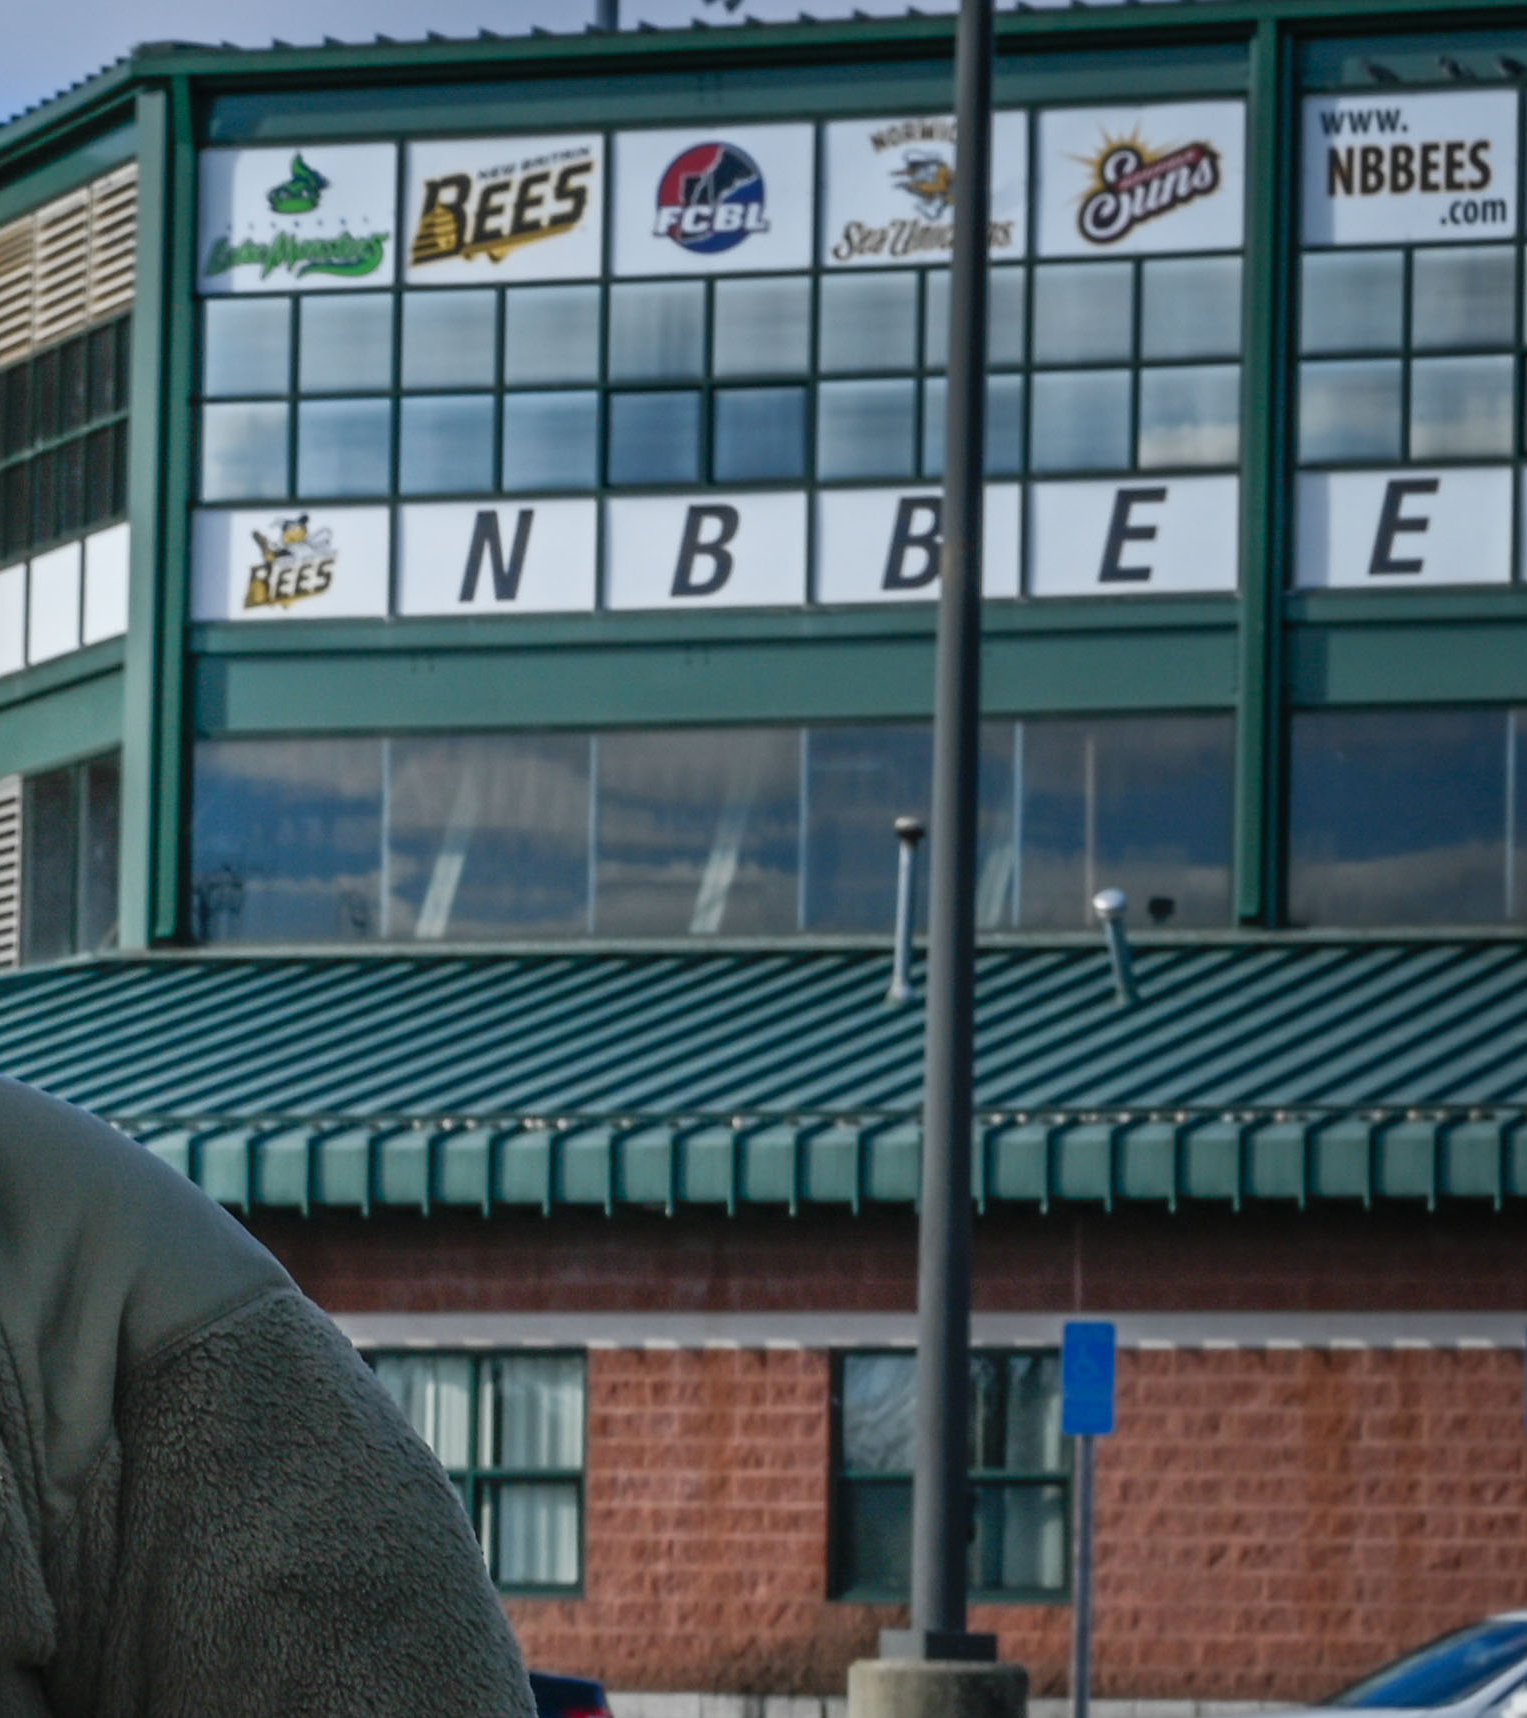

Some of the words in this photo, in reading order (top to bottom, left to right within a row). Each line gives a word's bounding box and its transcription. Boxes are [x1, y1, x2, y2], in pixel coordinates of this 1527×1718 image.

[1078, 143, 1220, 245] Suns
[1327, 138, 1492, 196] NBBEES
[411, 160, 594, 266] BEES
[653, 202, 770, 238] FCBL
[1440, 199, 1507, 226] .com
[244, 556, 335, 609] BEES
